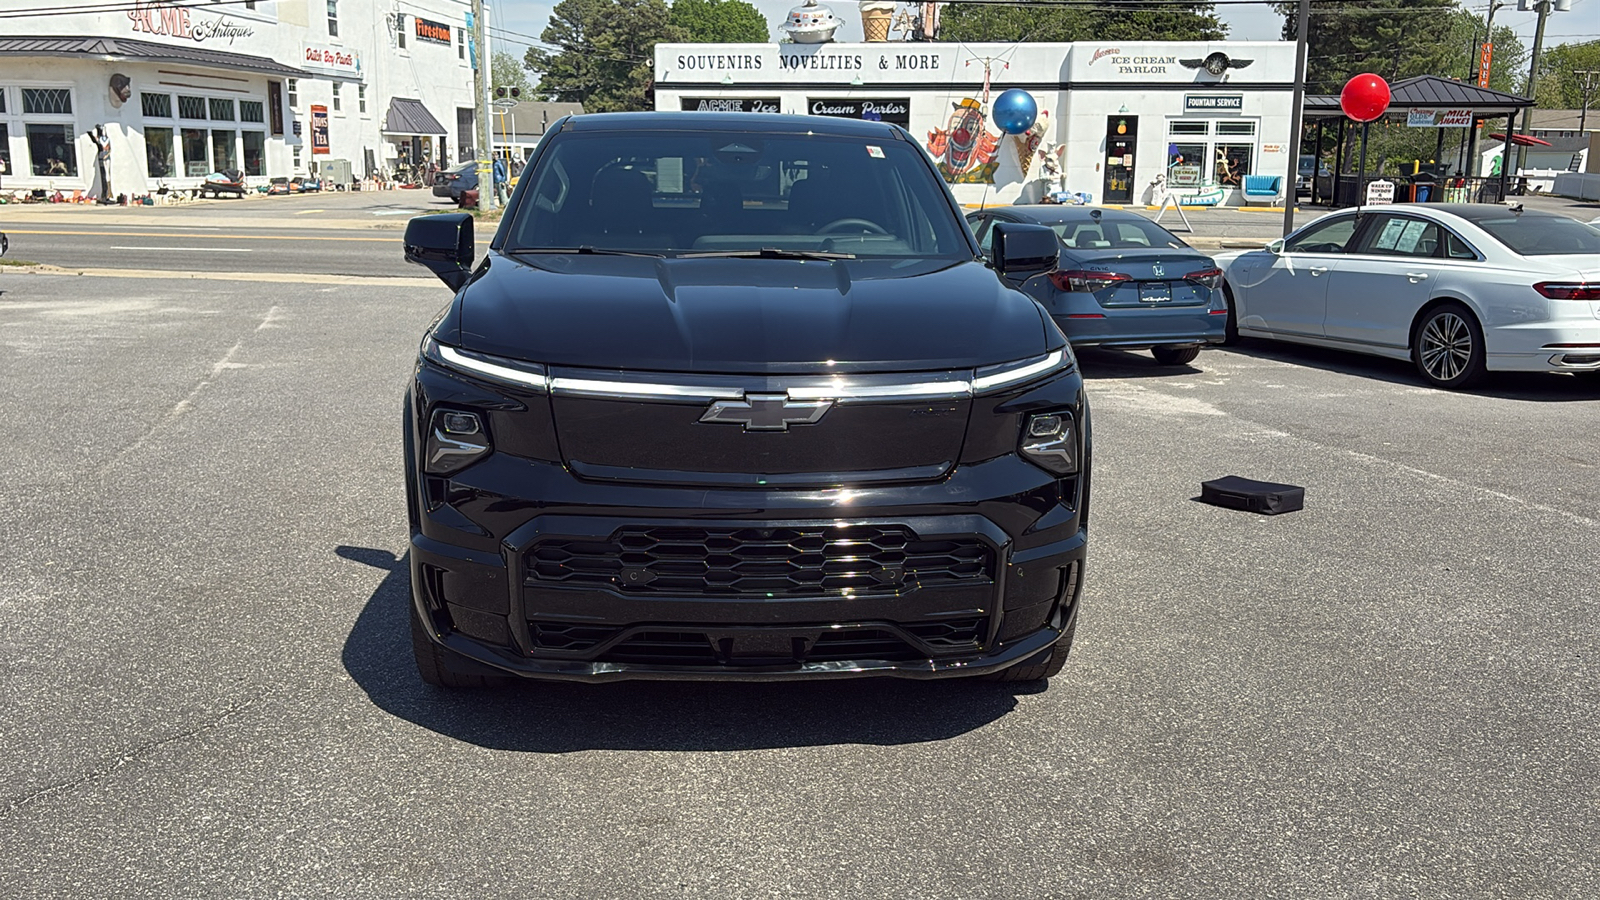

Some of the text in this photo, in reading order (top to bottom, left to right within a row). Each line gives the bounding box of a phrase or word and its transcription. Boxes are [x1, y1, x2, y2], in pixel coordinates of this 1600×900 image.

[127, 0, 255, 46] ACME Antiques
[415, 17, 450, 41] Firestone
[306, 47, 353, 67] Dutch Boy Paints
[678, 55, 940, 70] SOUVENIRS NOVELTIES & MORE
[1111, 56, 1131, 65] ICE
[1133, 56, 1177, 65] CREAM
[1119, 66, 1167, 74] PARLOR
[697, 99, 779, 113] ACME Ice
[812, 101, 907, 115] Cream Parlor
[1187, 98, 1240, 107] FOUNTAIN SERVICE
[1440, 117, 1471, 125] SHAKES
[315, 132, 328, 145] TEA
